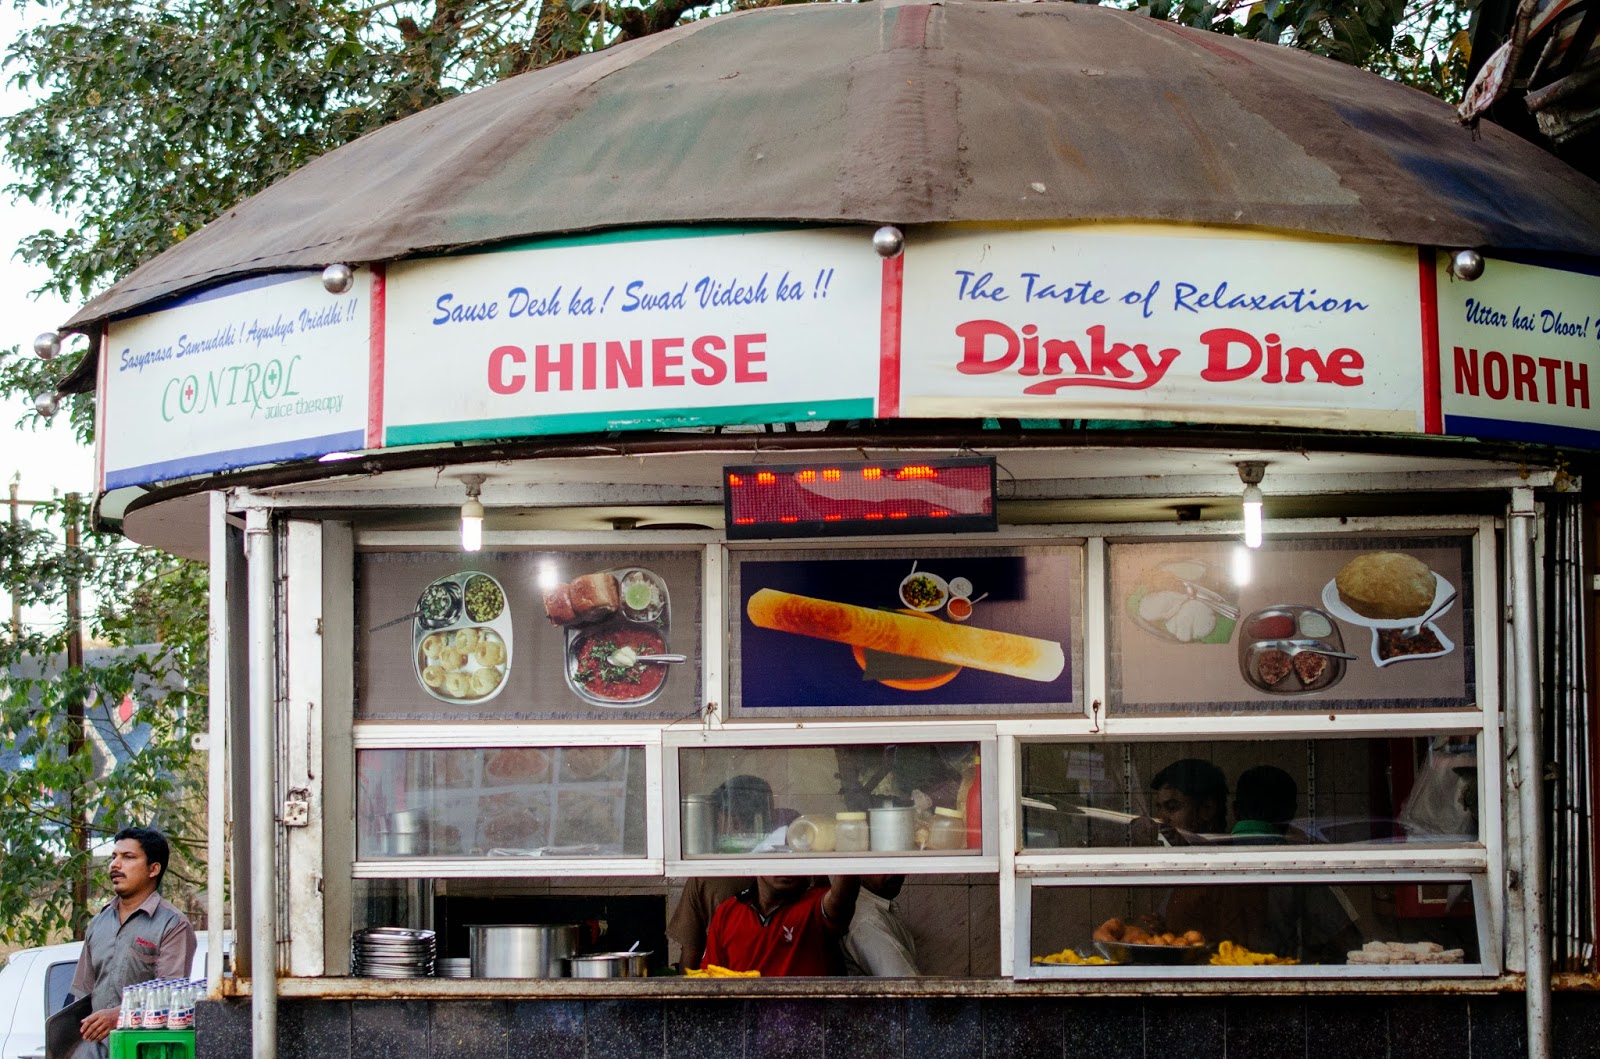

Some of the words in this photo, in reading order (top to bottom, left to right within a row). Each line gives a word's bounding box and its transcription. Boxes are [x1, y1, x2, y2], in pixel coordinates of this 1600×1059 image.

[433, 292, 499, 326] Sause
[507, 285, 563, 320] Desh
[621, 280, 690, 314] Swad
[694, 270, 770, 309] Videsh
[775, 272, 806, 301] ka
[954, 269, 1010, 304] The
[1021, 272, 1111, 305] Taste
[1119, 280, 1160, 319] of
[1173, 281, 1370, 315] Relaxation
[1465, 297, 1508, 328] Uttar
[1512, 305, 1536, 331] hai
[1541, 309, 1589, 338] Dhoor!
[120, 348, 173, 374] Sasyarasa
[176, 324, 236, 358] Samruddhi
[246, 315, 294, 347] Ayushya
[298, 302, 342, 331] Vriddhi
[487, 332, 768, 395] CHINESE
[954, 319, 1182, 395] Dinky
[1199, 326, 1366, 388] Dine
[161, 354, 302, 422] CONTROL
[1453, 346, 1590, 410] NORTH
